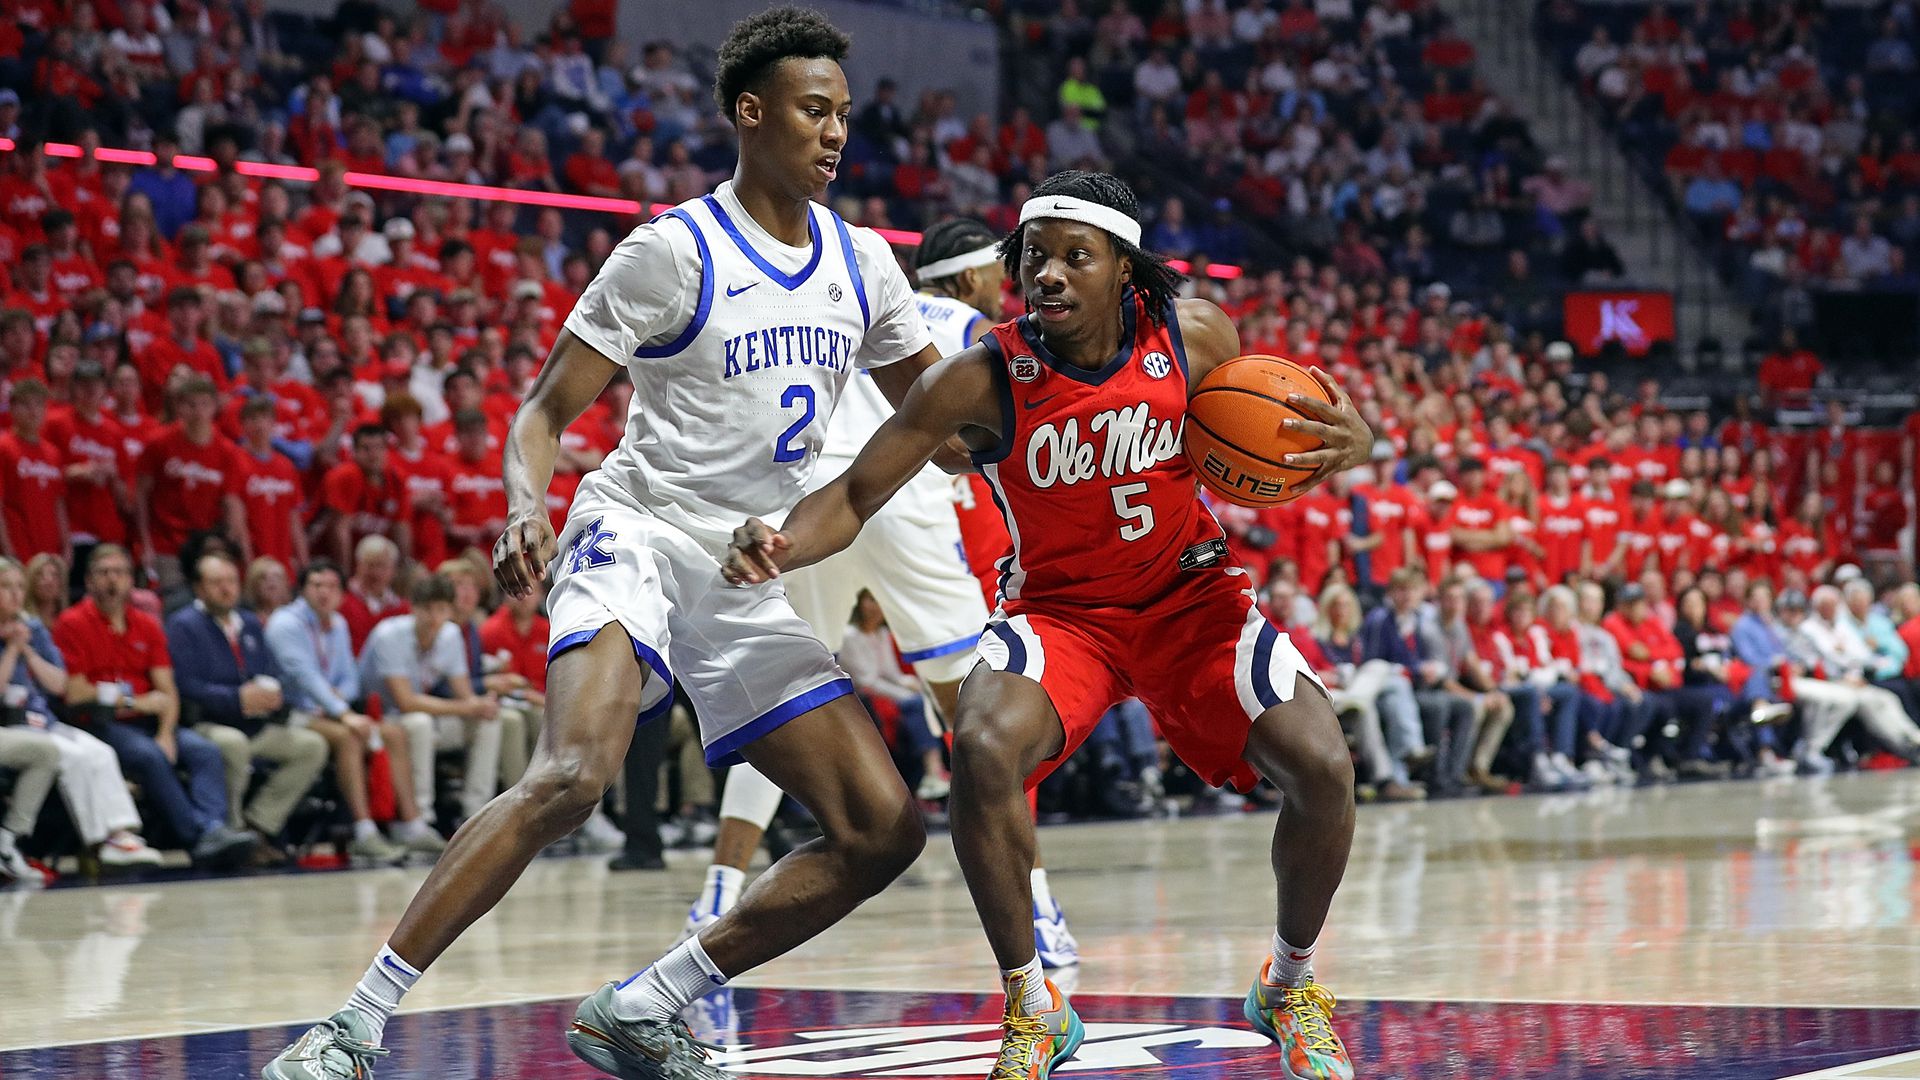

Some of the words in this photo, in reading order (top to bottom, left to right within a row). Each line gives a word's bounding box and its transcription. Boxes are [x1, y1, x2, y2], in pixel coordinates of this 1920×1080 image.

[724, 325, 852, 379] KENTUCKY
[1015, 364, 1035, 377] 22
[1143, 351, 1171, 379] SEC
[773, 384, 815, 463] 2
[1026, 416, 1097, 489] Ole
[1203, 452, 1283, 497] ELITE
[1110, 480, 1155, 542] 5
